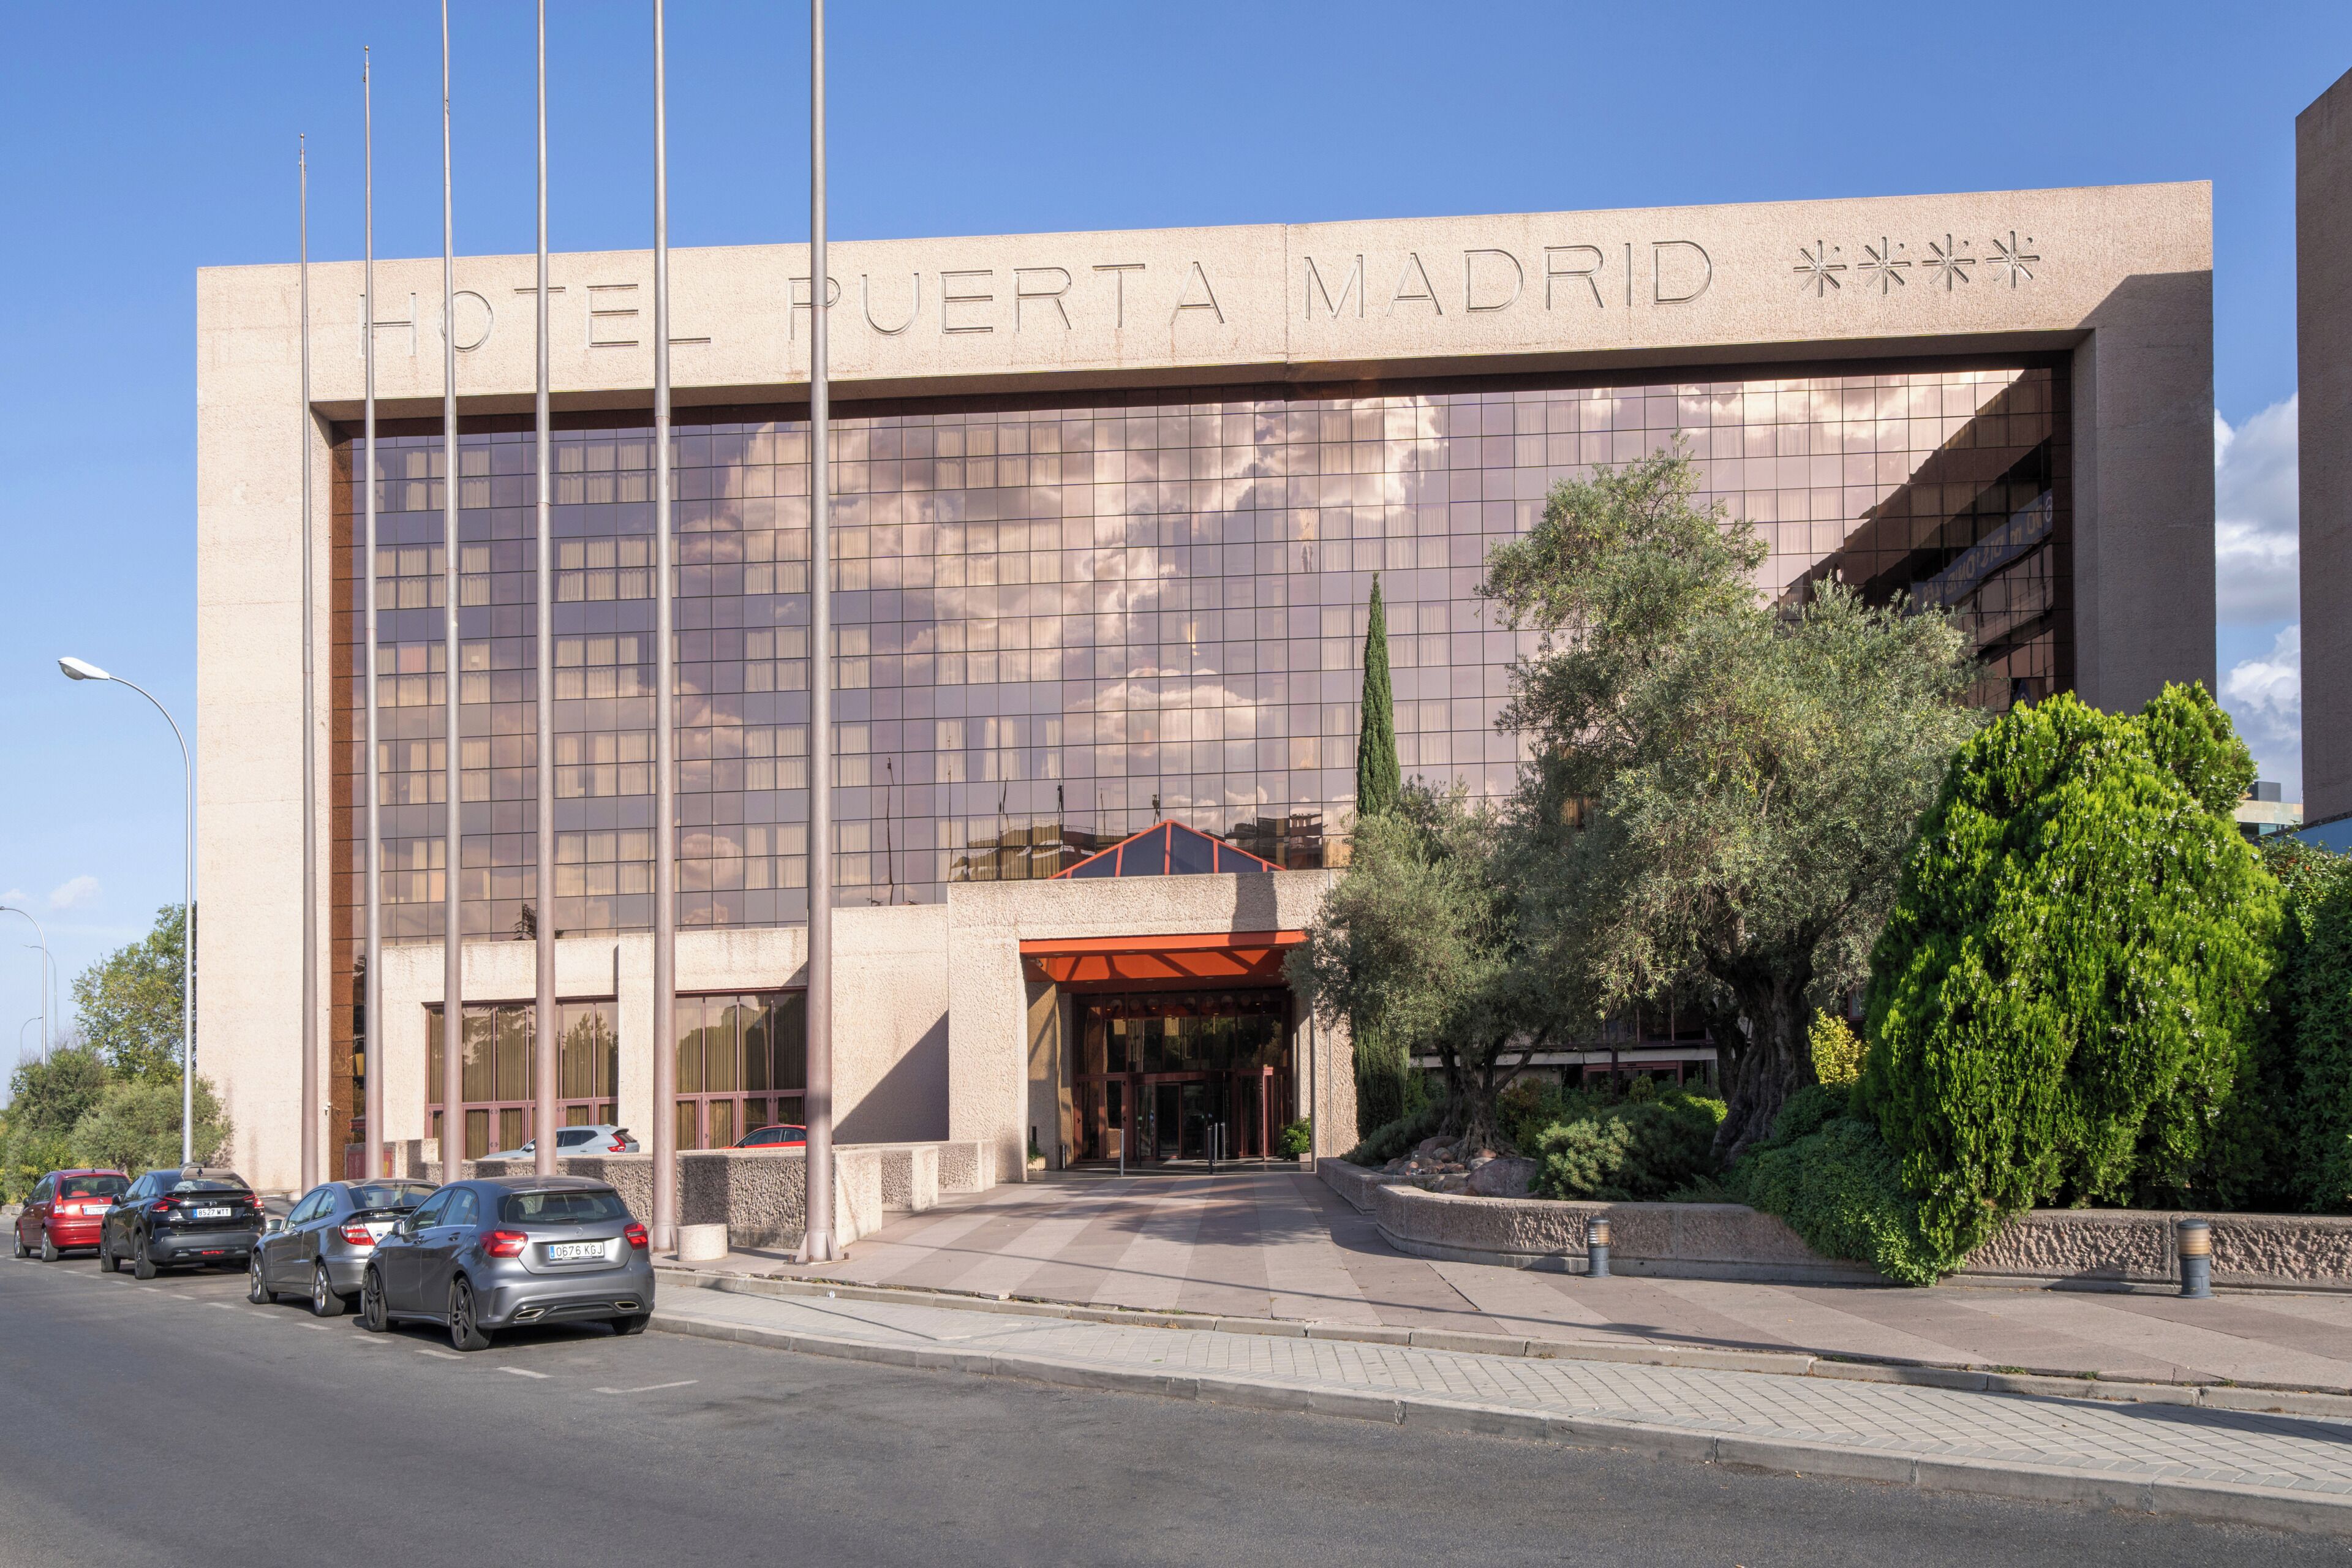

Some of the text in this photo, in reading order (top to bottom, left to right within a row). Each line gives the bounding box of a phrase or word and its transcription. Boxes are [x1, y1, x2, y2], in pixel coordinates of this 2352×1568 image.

[788, 261, 1225, 341] PUERTA
[1304, 239, 1713, 321] MADRID
[556, 1245, 603, 1257] 0676 KGJ
